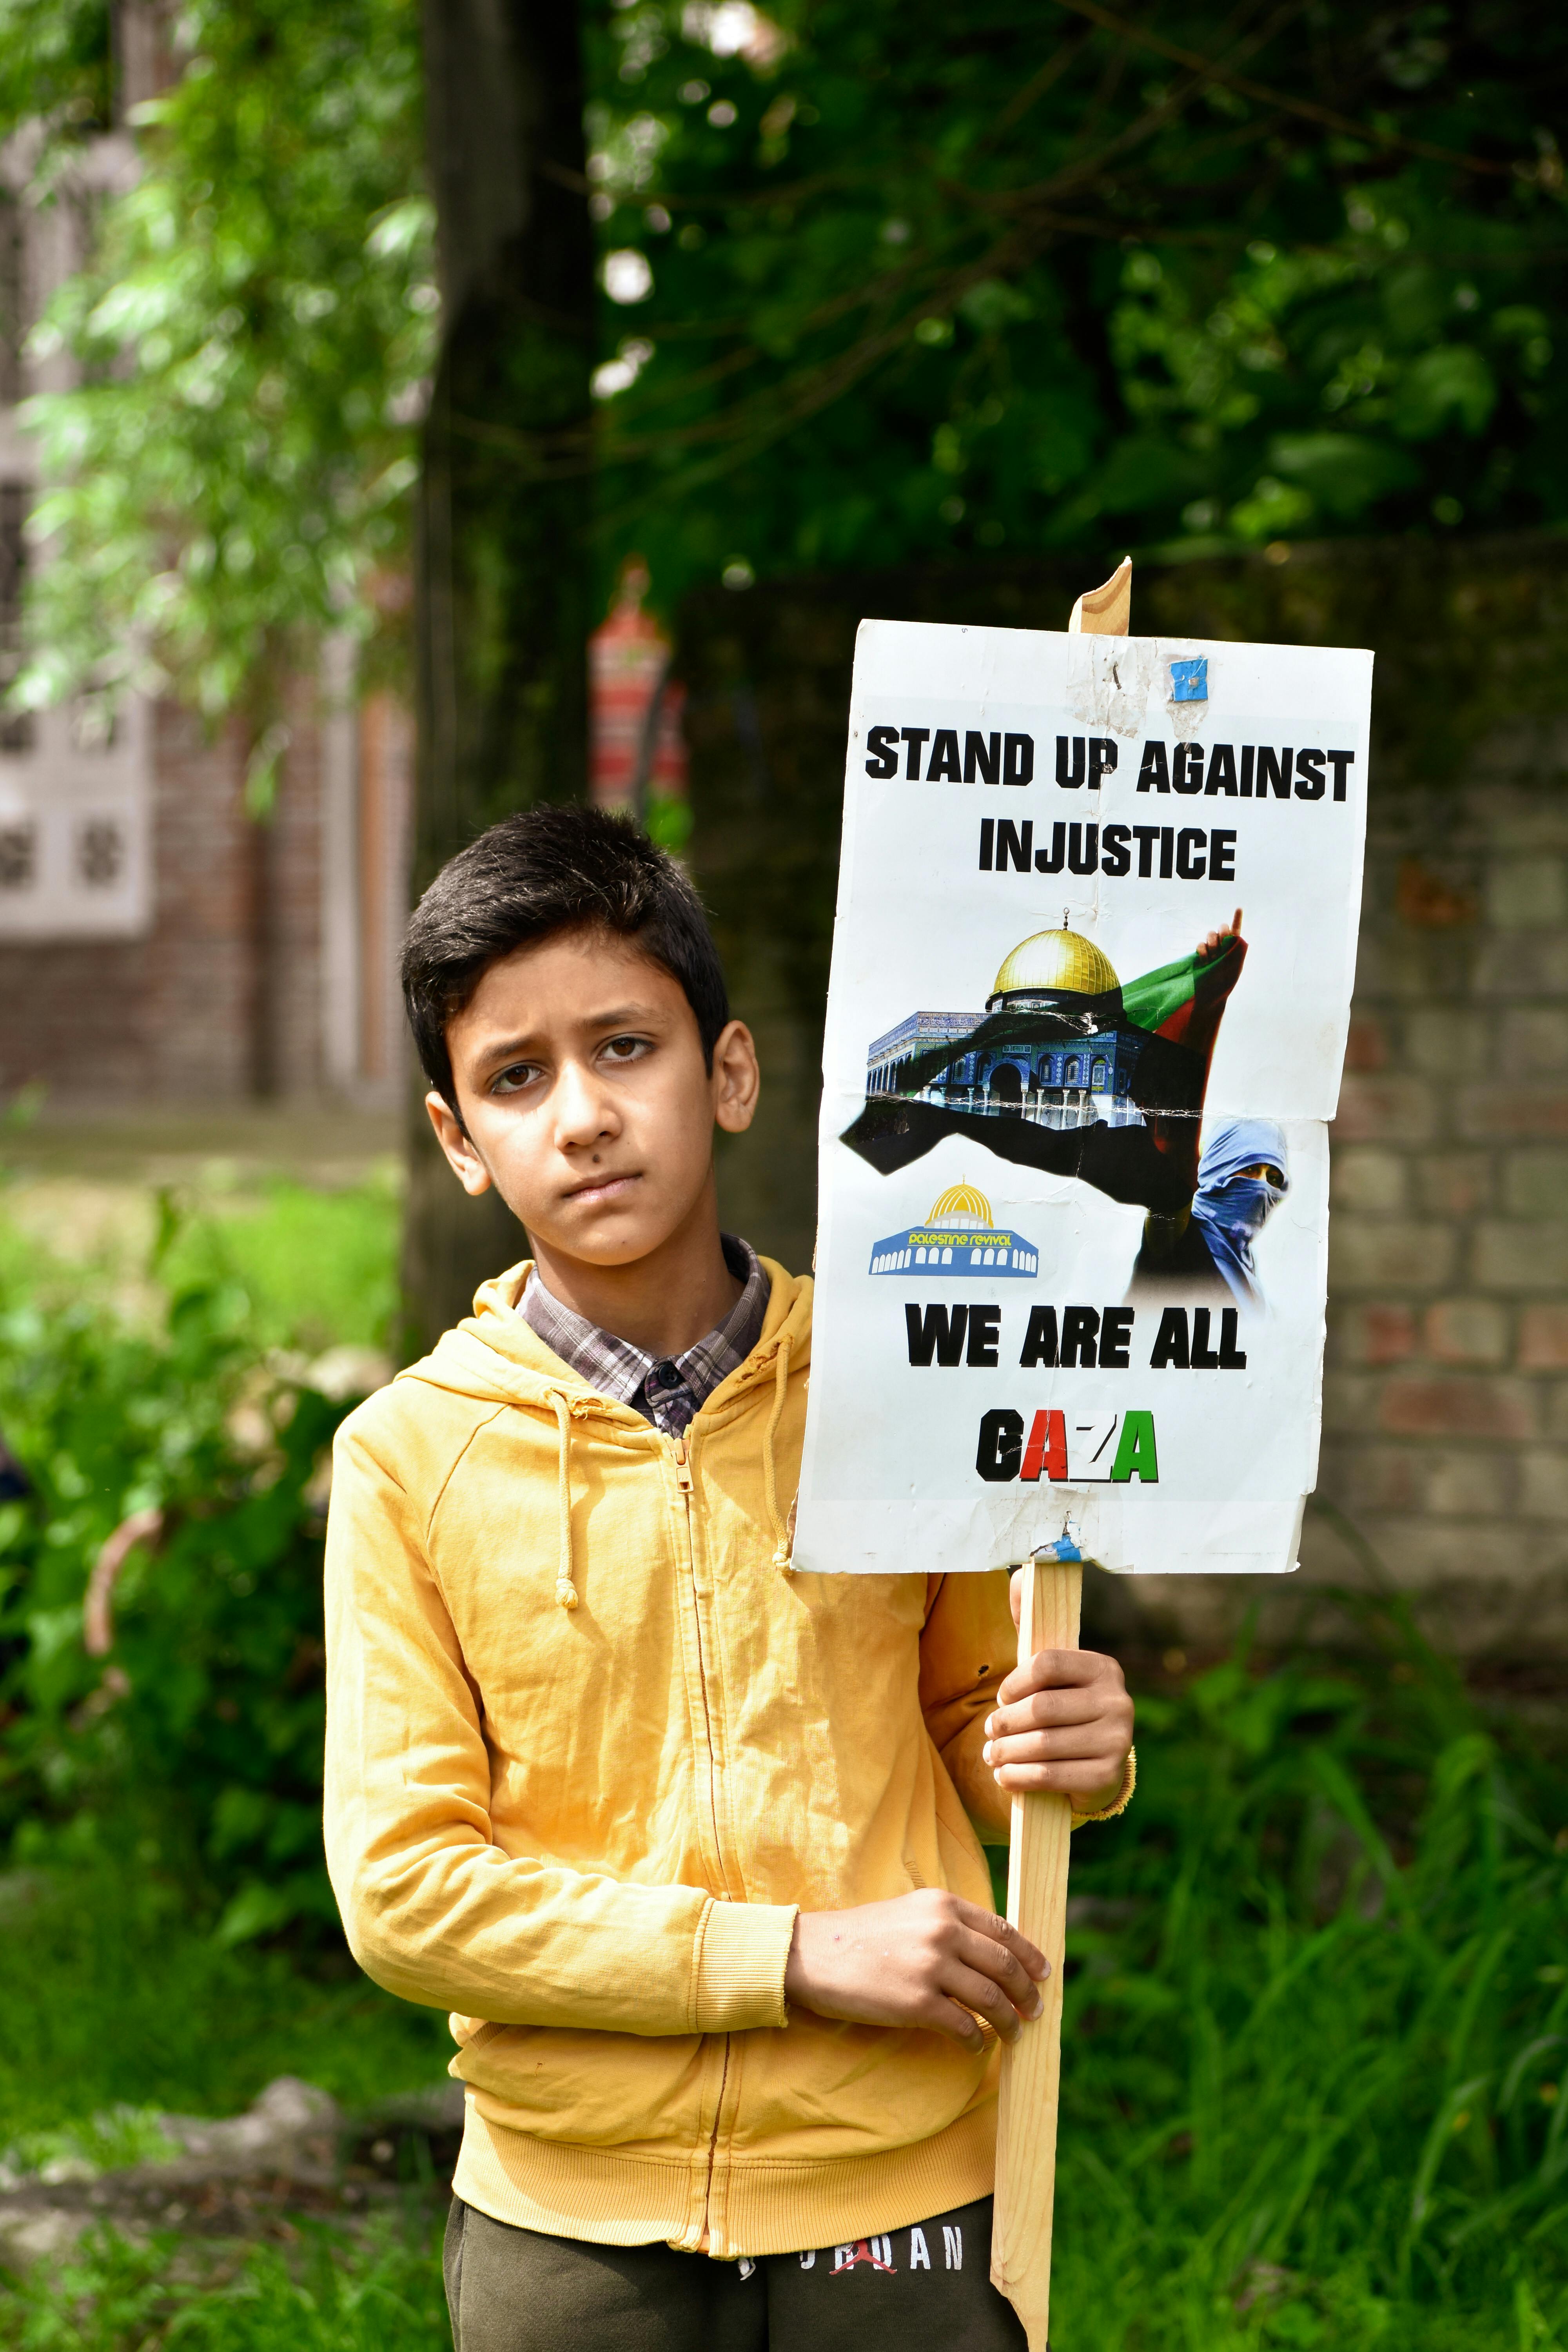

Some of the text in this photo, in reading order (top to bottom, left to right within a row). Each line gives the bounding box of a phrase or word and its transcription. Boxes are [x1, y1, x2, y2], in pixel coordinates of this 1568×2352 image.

[865, 726, 1355, 802] STAND UP AGAINST
[979, 818, 1237, 881] INJUSTICE
[905, 1303, 1247, 1370] WE ARE ALL
[975, 1409, 1159, 1483] GAZA
